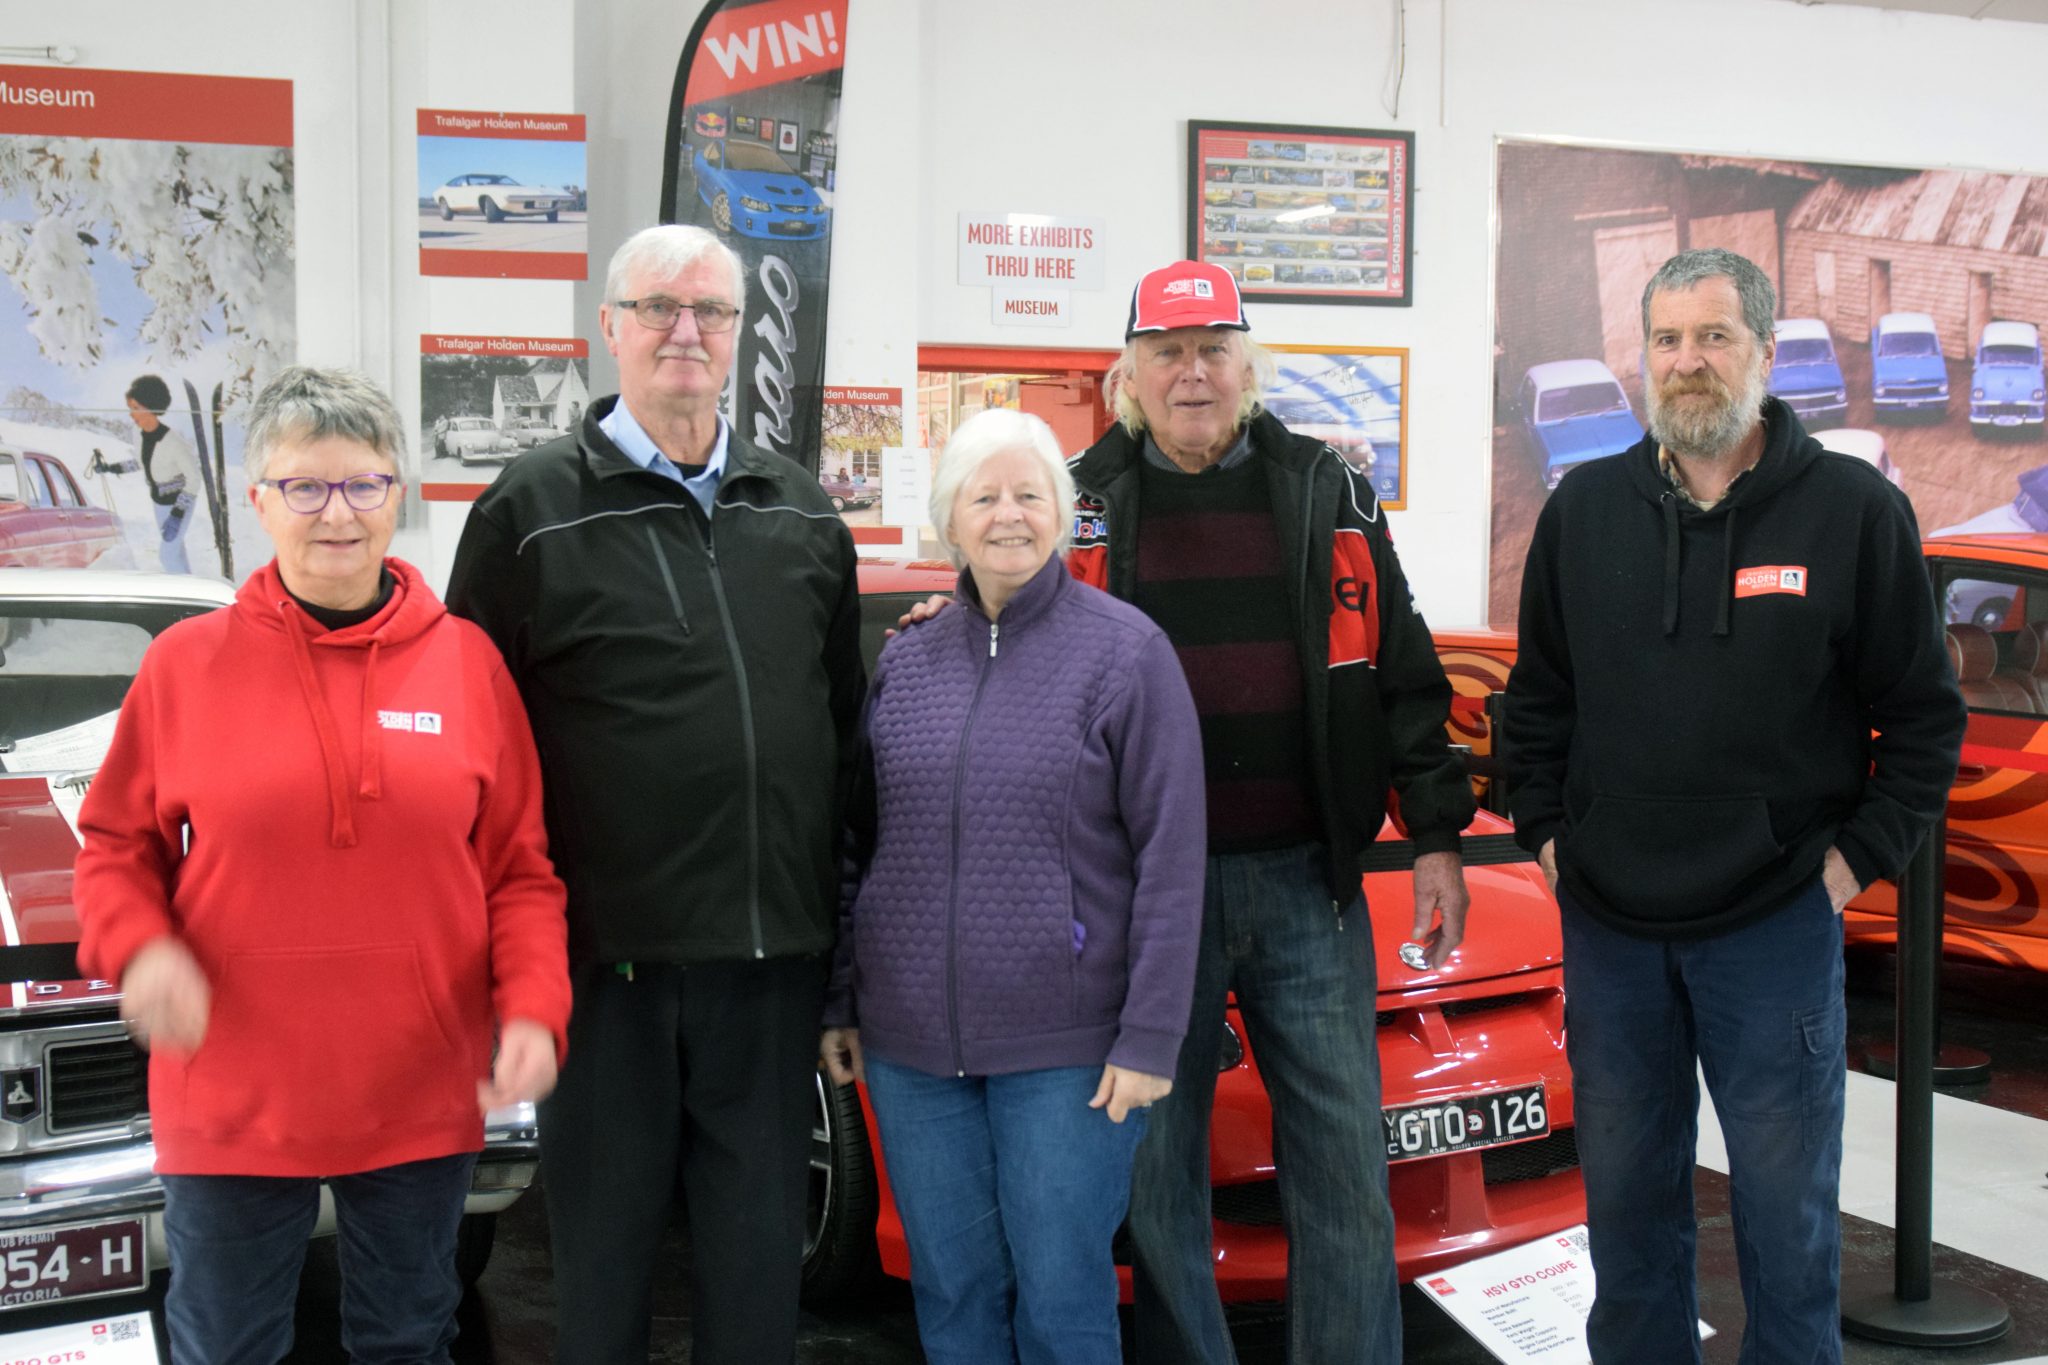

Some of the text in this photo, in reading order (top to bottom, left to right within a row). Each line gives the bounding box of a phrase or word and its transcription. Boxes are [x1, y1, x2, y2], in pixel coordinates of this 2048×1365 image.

[704, 10, 839, 80] WIN!
[435, 114, 568, 131] Trafalgar Holden Museum
[1392, 144, 1402, 274] HOLDEN LEGENDS
[967, 222, 1093, 249] MORE EXHIBITS
[986, 255, 1076, 279] THRU HERE
[1005, 300, 1058, 316] MUSEUM
[436, 337, 574, 352] Trafalgar Holden Museum
[753, 254, 799, 452] naro
[823, 388, 889, 400] lden Museum
[1738, 574, 1777, 586] HOLDEN
[1399, 1091, 1546, 1152] GTO 126
[0, 1232, 56, 1248] UB PERMIT
[0, 1244, 70, 1290] 54
[1482, 1283, 1508, 1298] HSV
[1508, 1274, 1536, 1289] GTO
[1536, 1260, 1578, 1280] COUPE
[0, 1286, 62, 1306] ICTORIA
[47, 1350, 86, 1365] GTS
